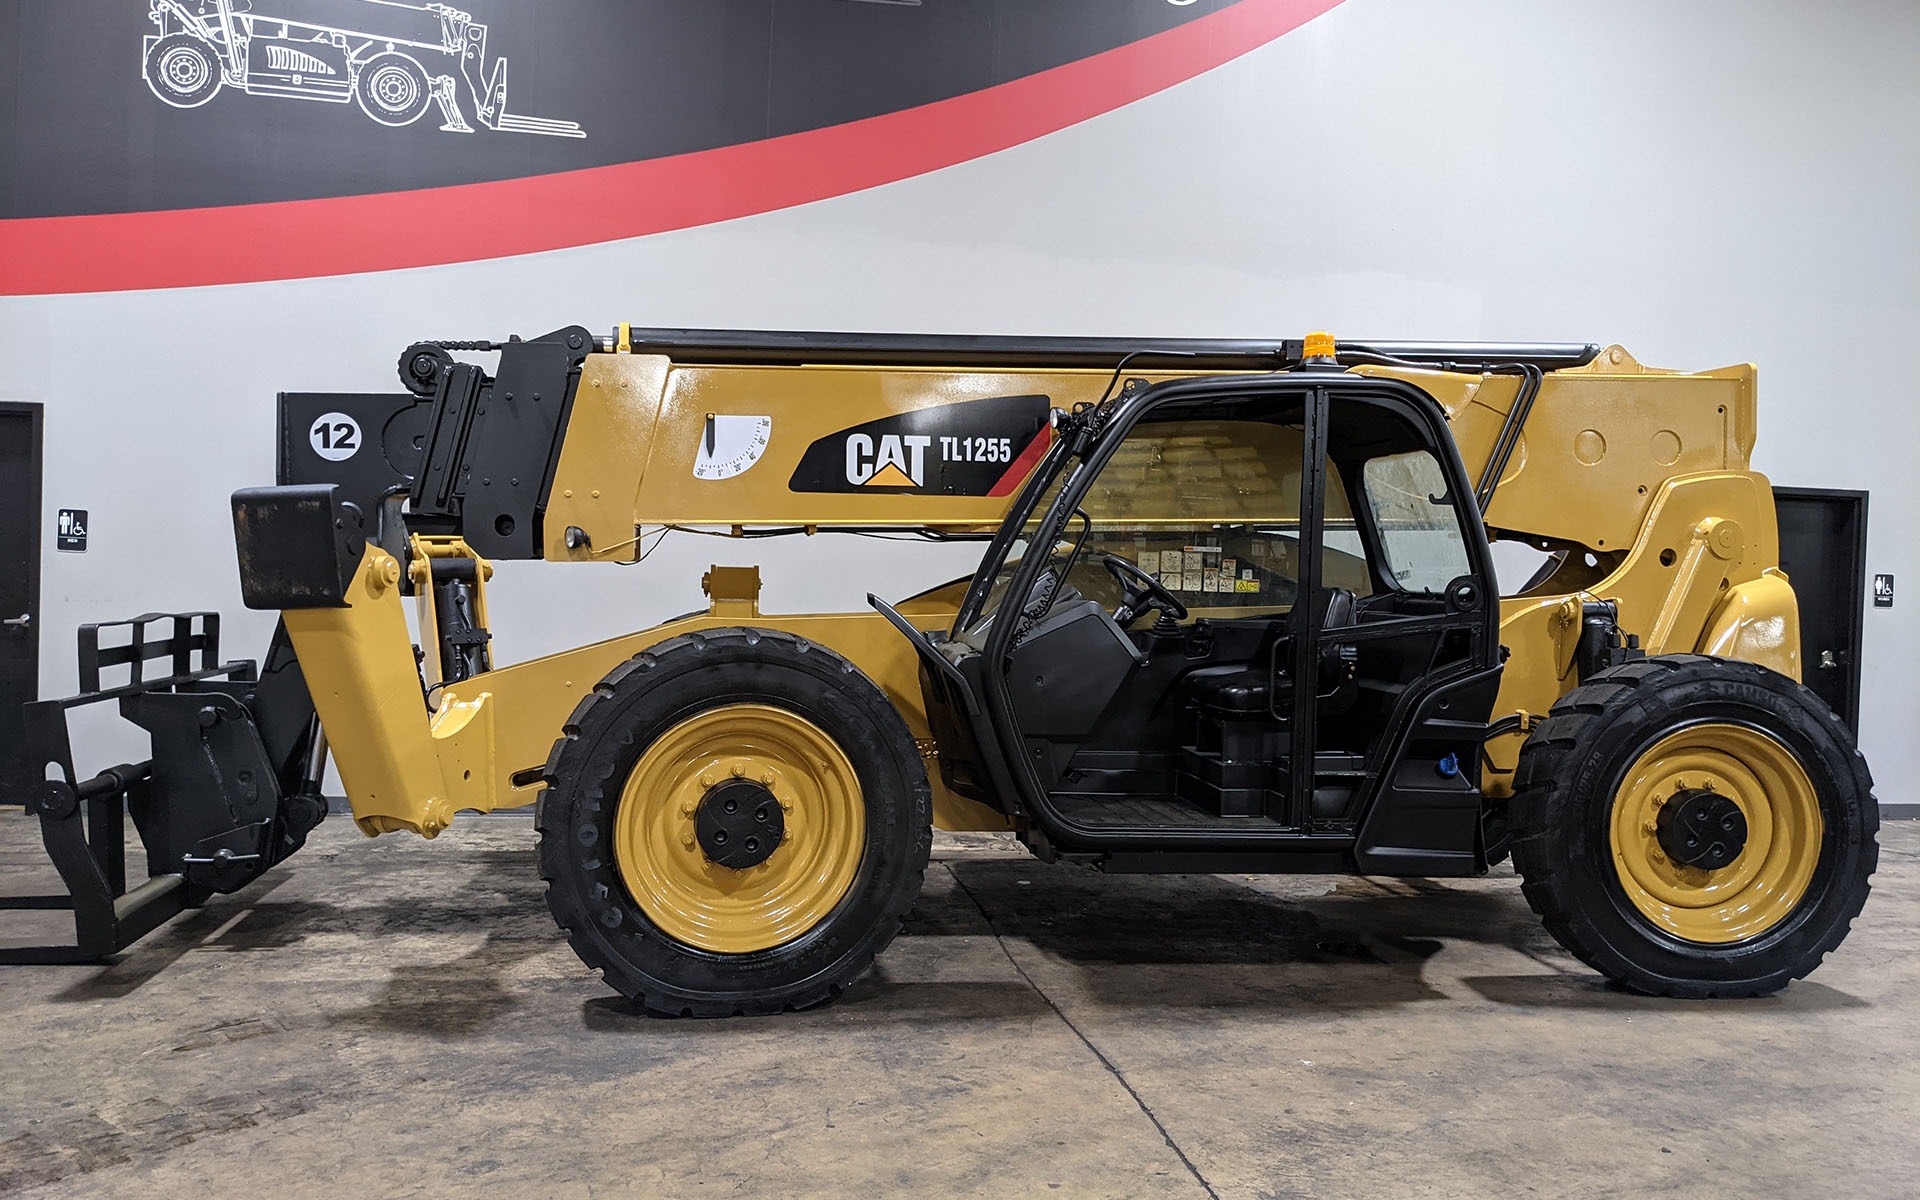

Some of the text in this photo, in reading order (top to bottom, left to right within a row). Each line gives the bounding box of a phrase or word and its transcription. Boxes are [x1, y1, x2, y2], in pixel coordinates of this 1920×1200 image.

[314, 423, 356, 449] 12
[846, 433, 1011, 487] CAT TL1255
